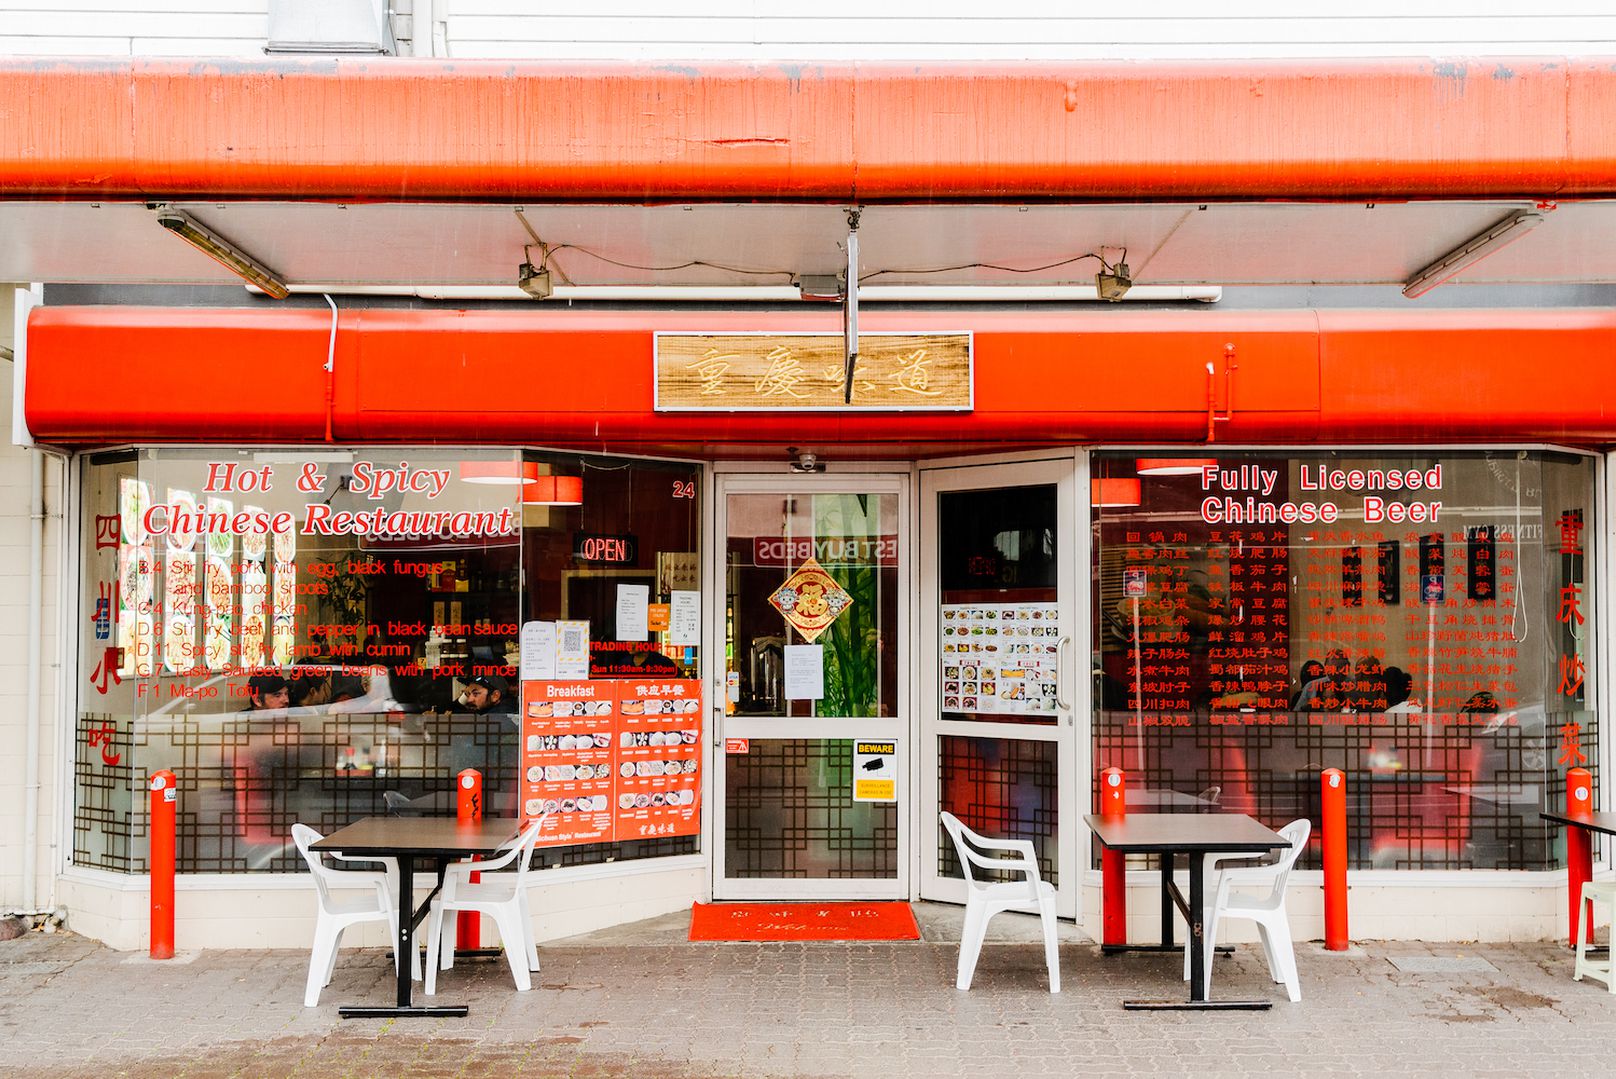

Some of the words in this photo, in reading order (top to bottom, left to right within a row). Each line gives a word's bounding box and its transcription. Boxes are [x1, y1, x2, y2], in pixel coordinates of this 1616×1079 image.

[202, 461, 274, 494] Hot
[296, 461, 327, 494] &
[349, 460, 451, 500] Spicy
[1201, 464, 1278, 496] Fully
[1300, 464, 1442, 490] Licensed
[672, 480, 695, 499] 24
[1201, 496, 1338, 524] Chinese
[1363, 496, 1442, 523] Beer
[143, 503, 292, 536] Chinese
[301, 504, 513, 537] Restaurant
[1126, 531, 1188, 543] 回锅肉
[1209, 531, 1287, 542] 豆花鸡片
[584, 538, 626, 562] OPEN
[1126, 548, 1190, 559] 鱼香肉丝
[138, 560, 163, 575] B.4
[171, 560, 194, 575] Stir
[203, 560, 222, 577] fry
[231, 560, 263, 577] pork
[270, 560, 299, 575] with
[308, 562, 339, 579] egg,
[348, 560, 387, 575] black
[394, 560, 444, 578] fungus
[174, 581, 203, 595] and
[211, 581, 272, 595] bamboo
[280, 581, 329, 595] shoots
[1404, 581, 1516, 593] 海芙蓉蛋
[252, 600, 308, 615] chicken
[1208, 597, 1287, 609] 家常豆腐
[203, 621, 222, 639] fry
[231, 621, 262, 636] beef
[271, 621, 299, 636] and
[307, 624, 358, 639] pepper
[367, 621, 380, 636] in
[388, 621, 426, 636] black
[474, 623, 518, 636] sauce
[89, 514, 122, 766] 四川小吃
[589, 641, 633, 651] TRADING
[636, 641, 665, 652] HOUR
[1555, 515, 1586, 766] 重庆炒菜
[181, 642, 221, 660] Spicy
[259, 642, 277, 660] fry
[285, 642, 321, 656] lamb
[329, 642, 359, 656] with
[367, 642, 410, 656] cumin
[173, 663, 212, 680] Tasty
[222, 662, 282, 677] Sauteed
[291, 664, 333, 680] green
[341, 662, 387, 677] beans
[395, 662, 425, 677] with
[432, 662, 465, 680] pork
[473, 664, 517, 677] mince
[591, 665, 607, 673] Sun
[1126, 665, 1190, 677] 水煮牛肉
[1307, 664, 1387, 676] 香辣小龙虾
[170, 683, 218, 700] Ma-po
[226, 683, 259, 698] Tofu
[547, 685, 595, 697] Breakfast
[635, 684, 685, 696] 供应早餐
[1127, 681, 1191, 693] 东坡肘子
[1307, 681, 1387, 693] 川味炒腊肉
[1127, 698, 1190, 710] 四川扣肉
[858, 744, 894, 754] BEWARE
